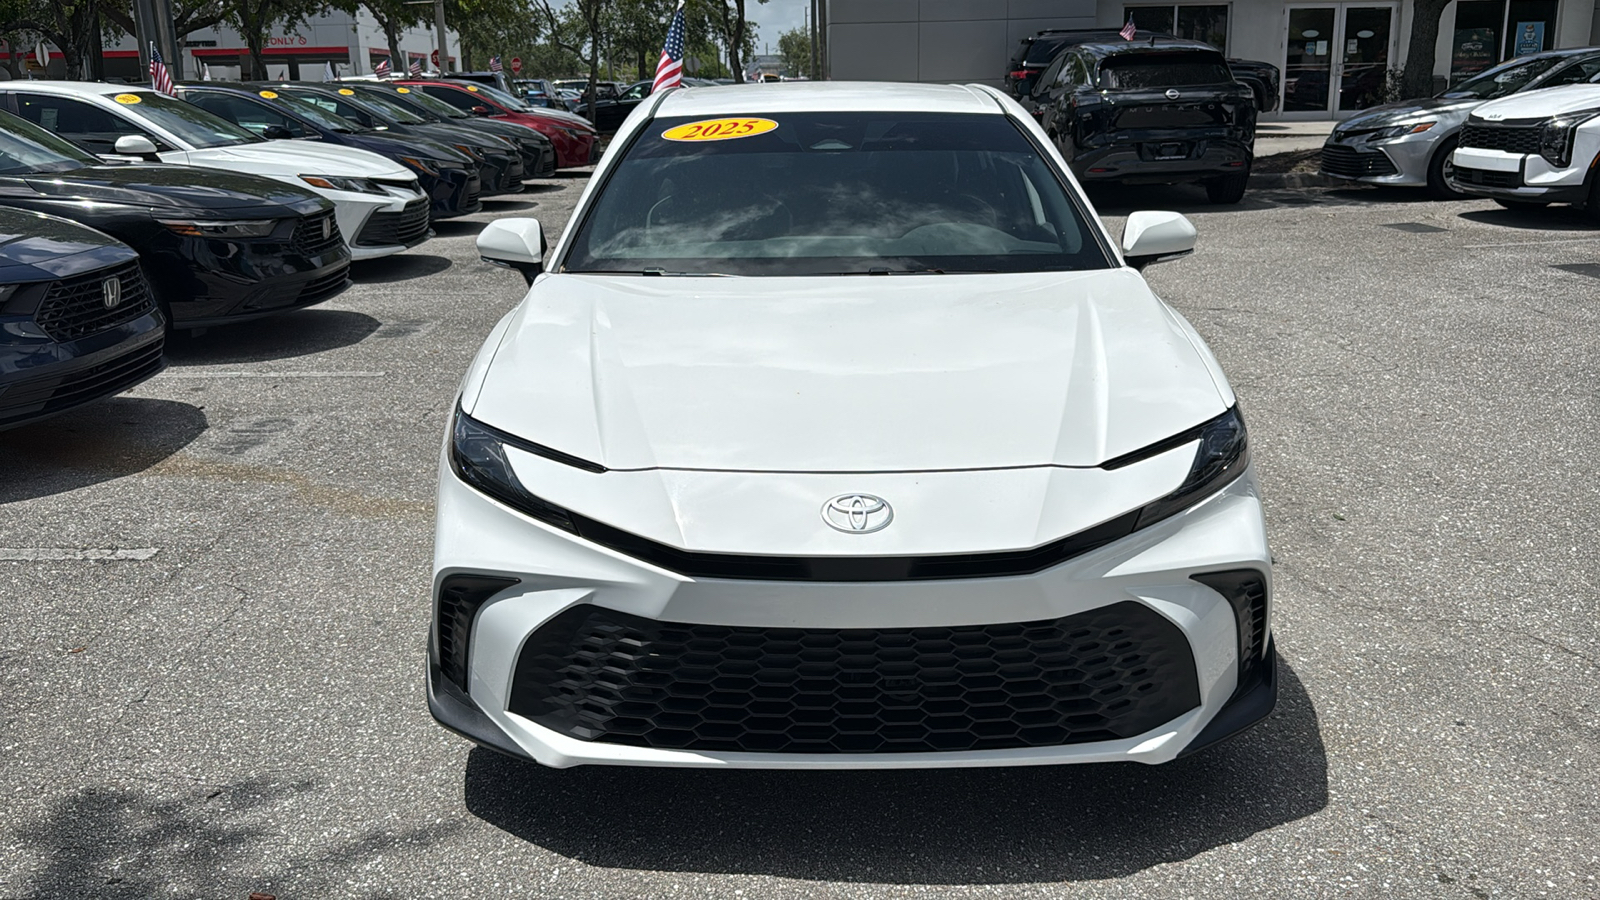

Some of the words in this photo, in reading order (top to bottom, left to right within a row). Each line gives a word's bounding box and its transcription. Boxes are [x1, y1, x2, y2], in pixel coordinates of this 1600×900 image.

[270, 37, 295, 45] ONLY
[1129, 104, 1215, 113] MURANO
[681, 120, 760, 139] 2025
